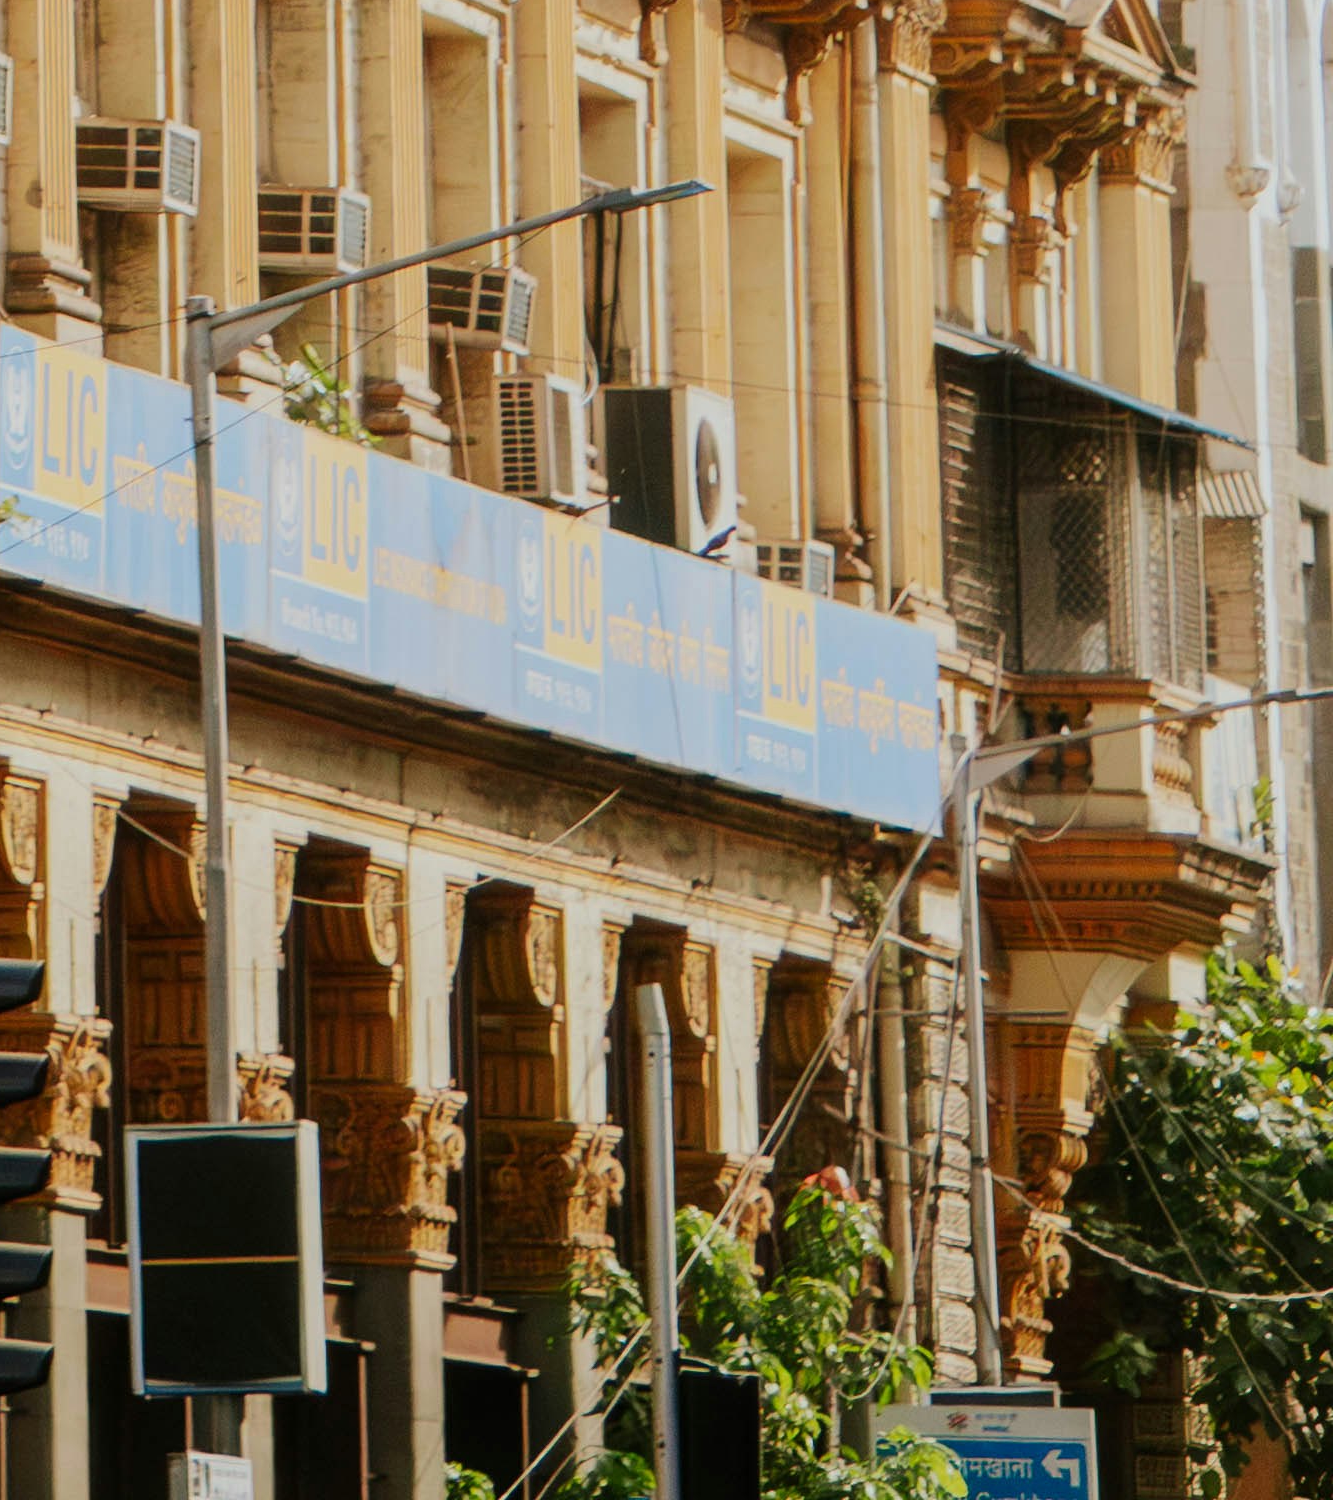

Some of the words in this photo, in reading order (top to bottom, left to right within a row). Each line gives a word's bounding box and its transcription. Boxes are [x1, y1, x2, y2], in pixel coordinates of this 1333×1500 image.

[43, 362, 98, 487] LIC
[310, 454, 361, 573] LIC
[550, 533, 597, 645] LIC
[768, 602, 810, 706] LIC
